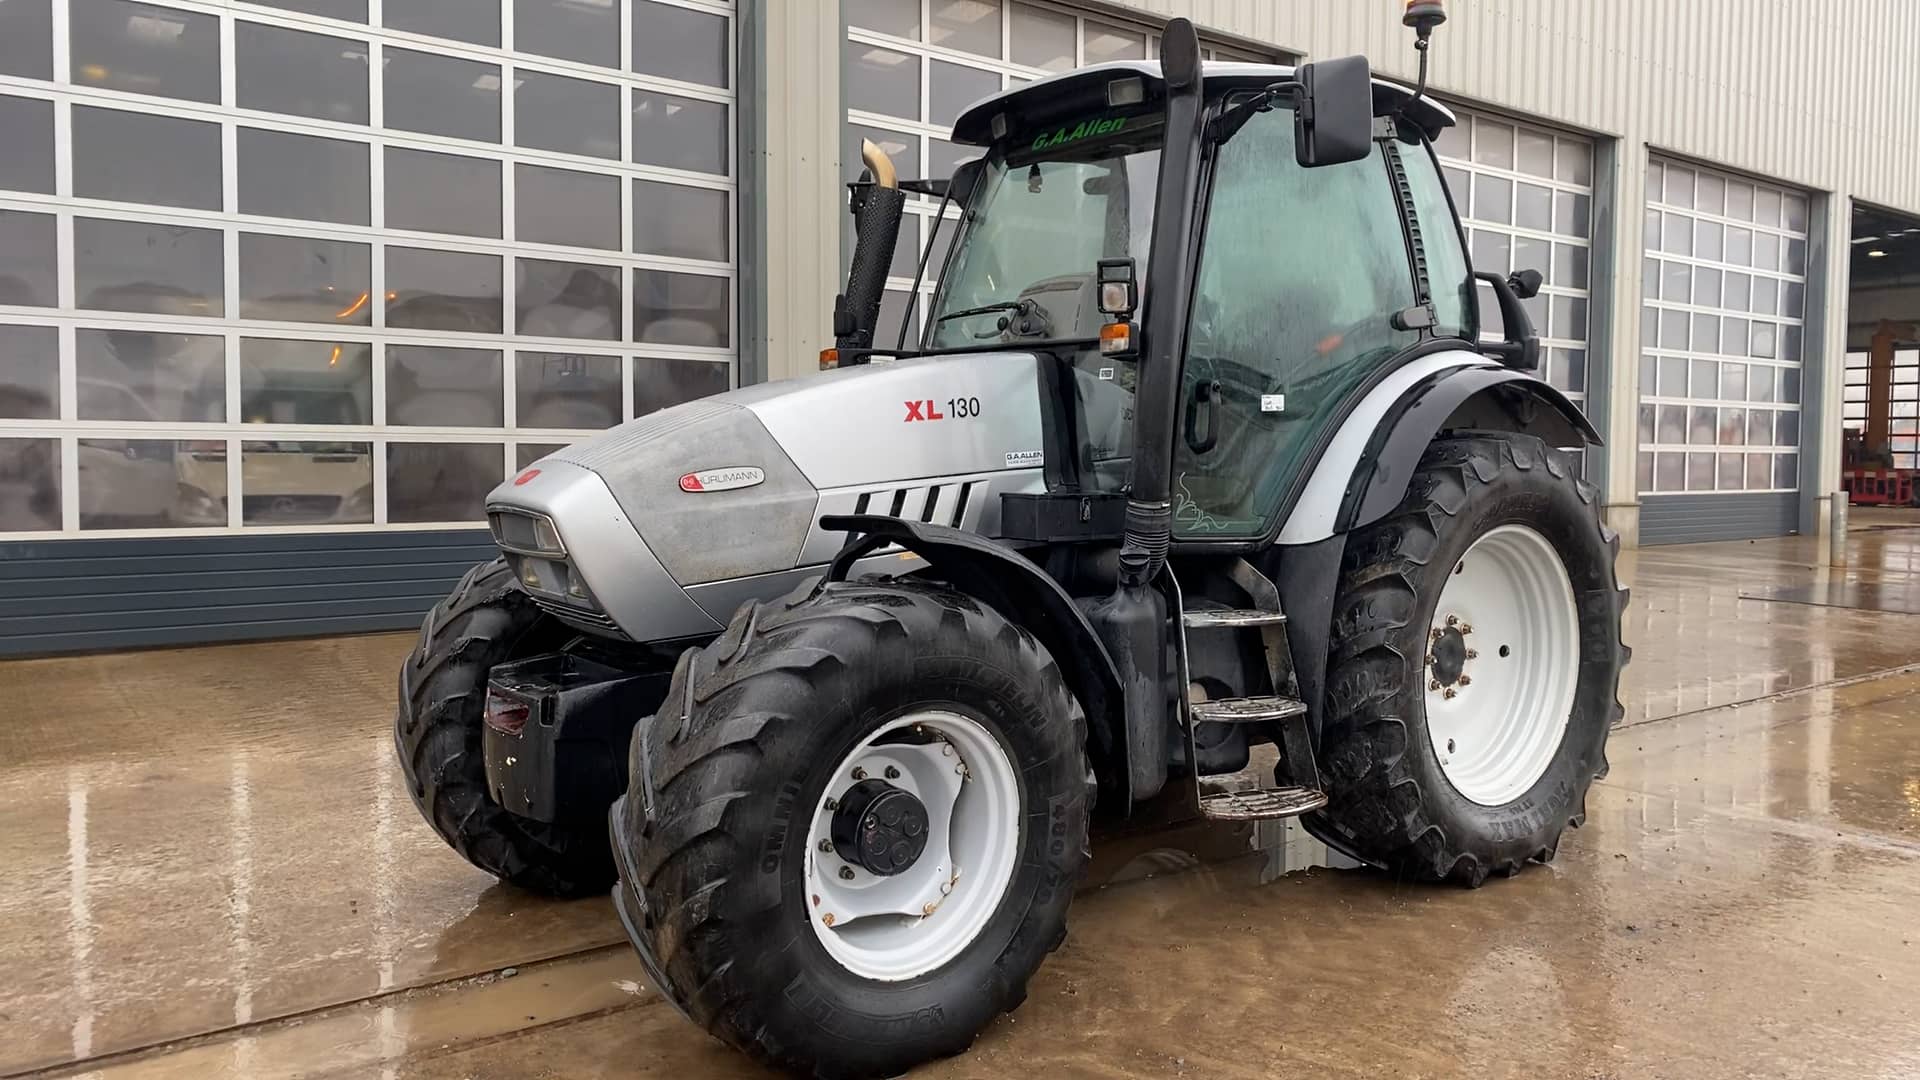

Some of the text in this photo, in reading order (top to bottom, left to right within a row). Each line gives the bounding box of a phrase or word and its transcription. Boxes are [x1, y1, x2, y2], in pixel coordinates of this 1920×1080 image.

[1032, 117, 1127, 150] G.A.Allen
[904, 397, 980, 422] XL 130
